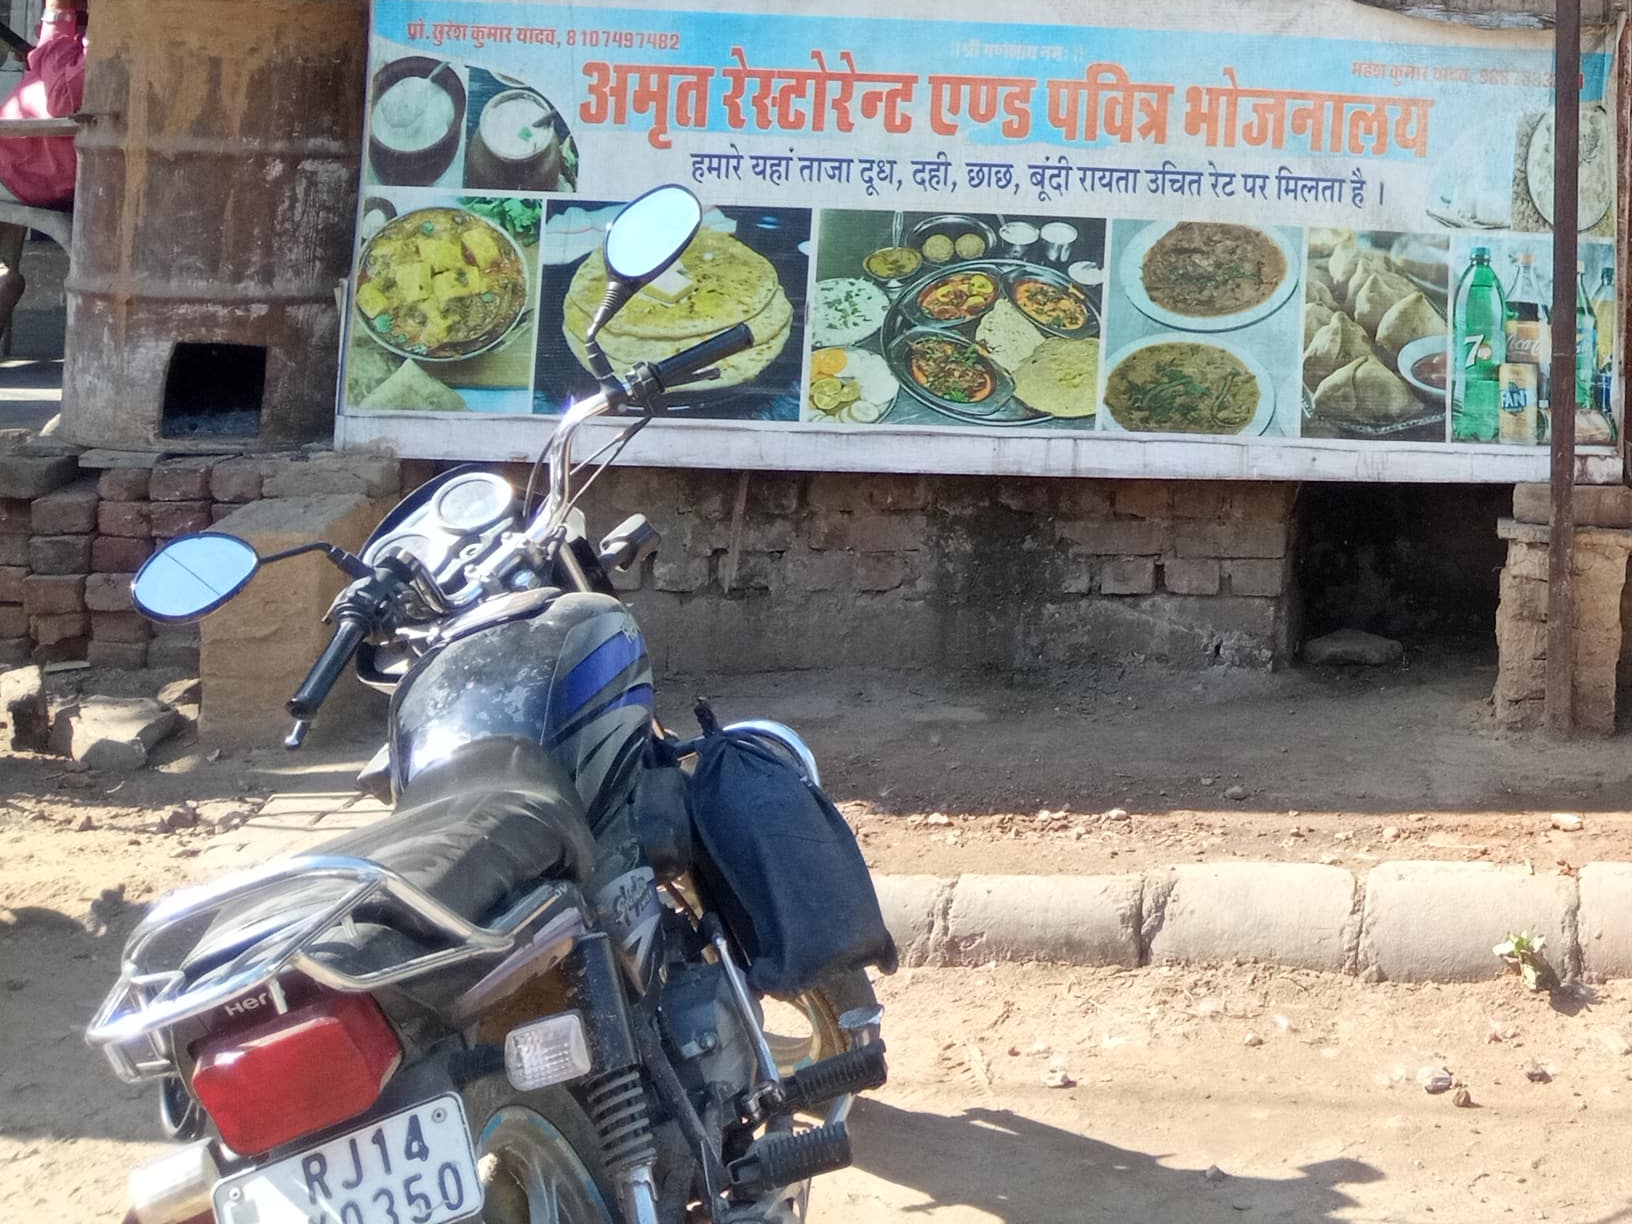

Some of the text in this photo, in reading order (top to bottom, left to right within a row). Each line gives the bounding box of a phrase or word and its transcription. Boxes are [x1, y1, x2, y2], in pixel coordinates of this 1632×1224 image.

[580, 46, 1434, 157] अमृत रेस्टोरेन्ट एण्ड पवित्र भोजनालय
[691, 144, 743, 182] हमारे
[750, 147, 796, 186] यहां
[798, 157, 854, 185] ताजा
[858, 159, 904, 196] दूध,
[911, 152, 957, 192] दही,
[966, 163, 1020, 196] छाछ,
[1028, 155, 1073, 203] बूंदी
[1077, 167, 1143, 194] रायता
[1145, 164, 1203, 198] उचित
[1210, 161, 1238, 197] रेट
[1241, 173, 1271, 200] पर
[1275, 166, 1347, 204] मिलता
[1350, 167, 1367, 209] है
[301, 1114, 429, 1205] RJ14
[308, 1161, 465, 1224] 0350
